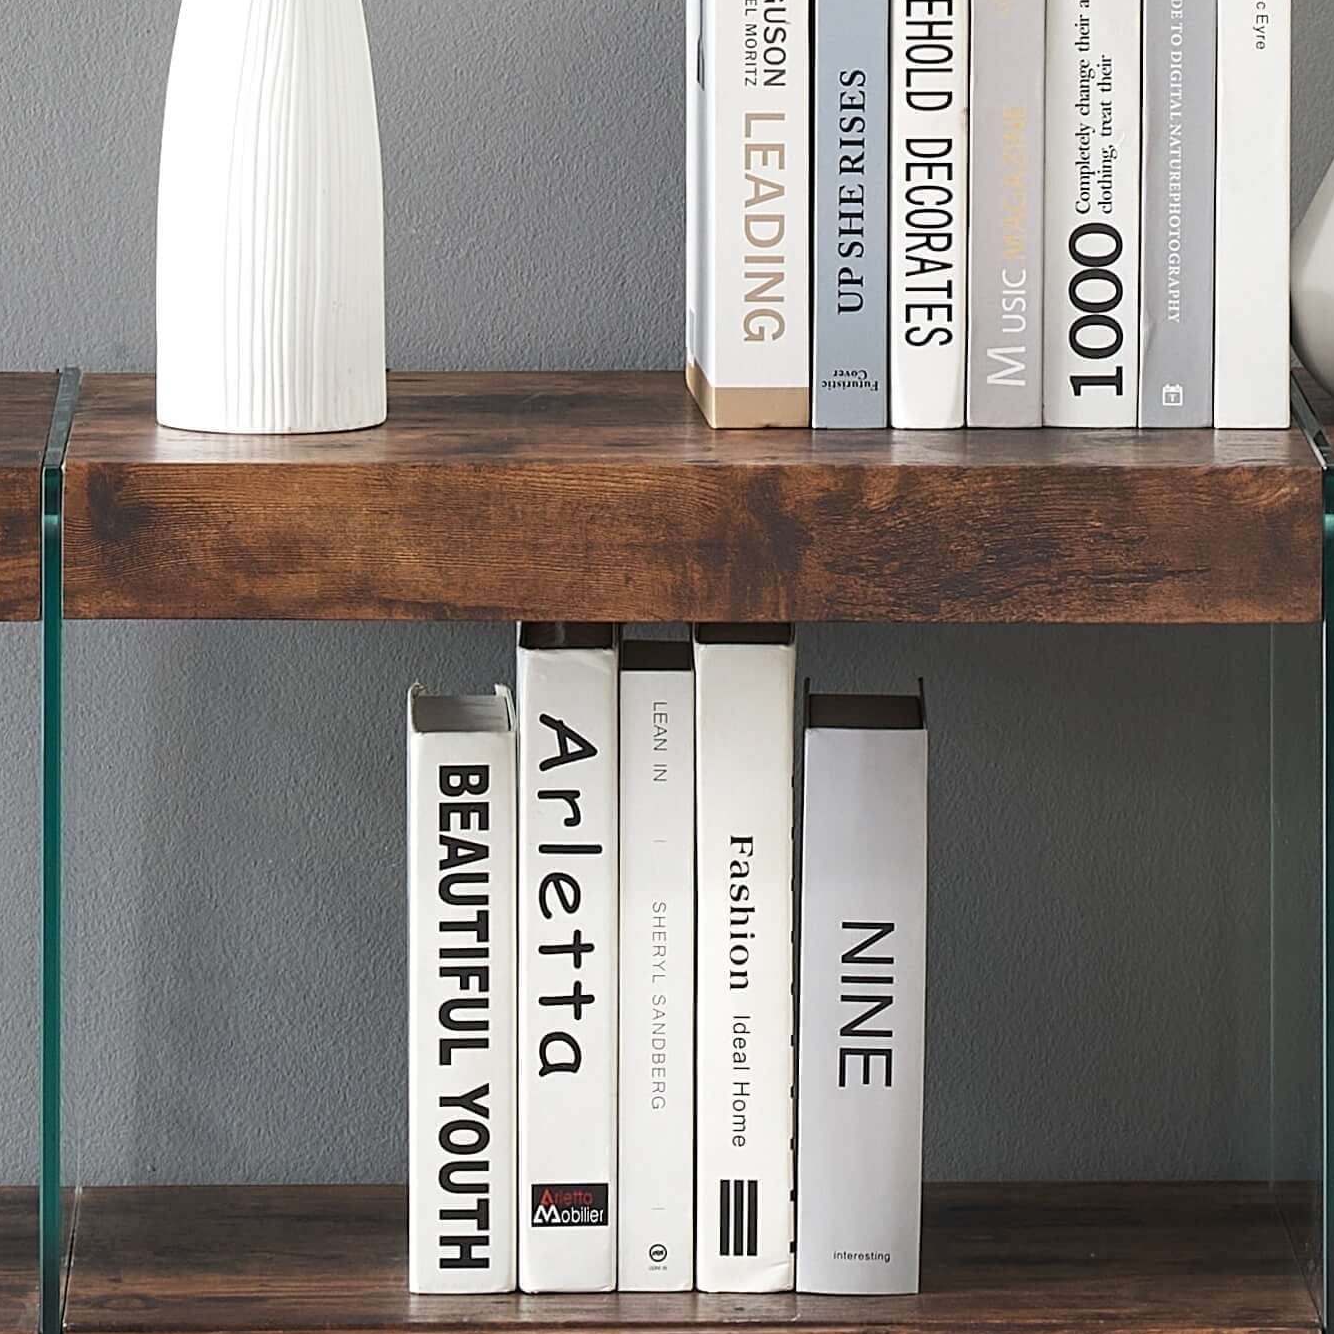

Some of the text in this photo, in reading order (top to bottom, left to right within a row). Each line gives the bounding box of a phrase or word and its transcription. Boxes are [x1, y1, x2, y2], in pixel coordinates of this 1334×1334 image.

[745, 24, 757, 86] MORITZ
[1075, 14, 1089, 51] their
[1170, 22, 1183, 47] TO
[1252, 14, 1269, 50] Eyre
[1074, 58, 1095, 116] change
[1169, 50, 1183, 121] DIGITAL
[1074, 123, 1095, 215] Completely
[1097, 55, 1117, 214] clothing, treat their
[743, 113, 785, 341] LEADING
[838, 70, 866, 315] UP SHE RISES
[905, 139, 953, 346] DECORATES
[1069, 223, 1123, 396] 1000
[822, 381, 878, 391] Futuristic
[834, 370, 867, 380] Cover
[653, 702, 667, 781] LEAN IN
[537, 714, 602, 1077] Arletta
[730, 836, 755, 989] Fashion
[439, 765, 490, 1269] BEAUTIFUL YOUTH
[652, 902, 666, 1109] SHERYL SANDBERG
[839, 922, 894, 1087] NINE
[732, 1016, 750, 1147] Ideal Home
[533, 1205, 604, 1224] Mobilier
[834, 1251, 890, 1263] interesting
